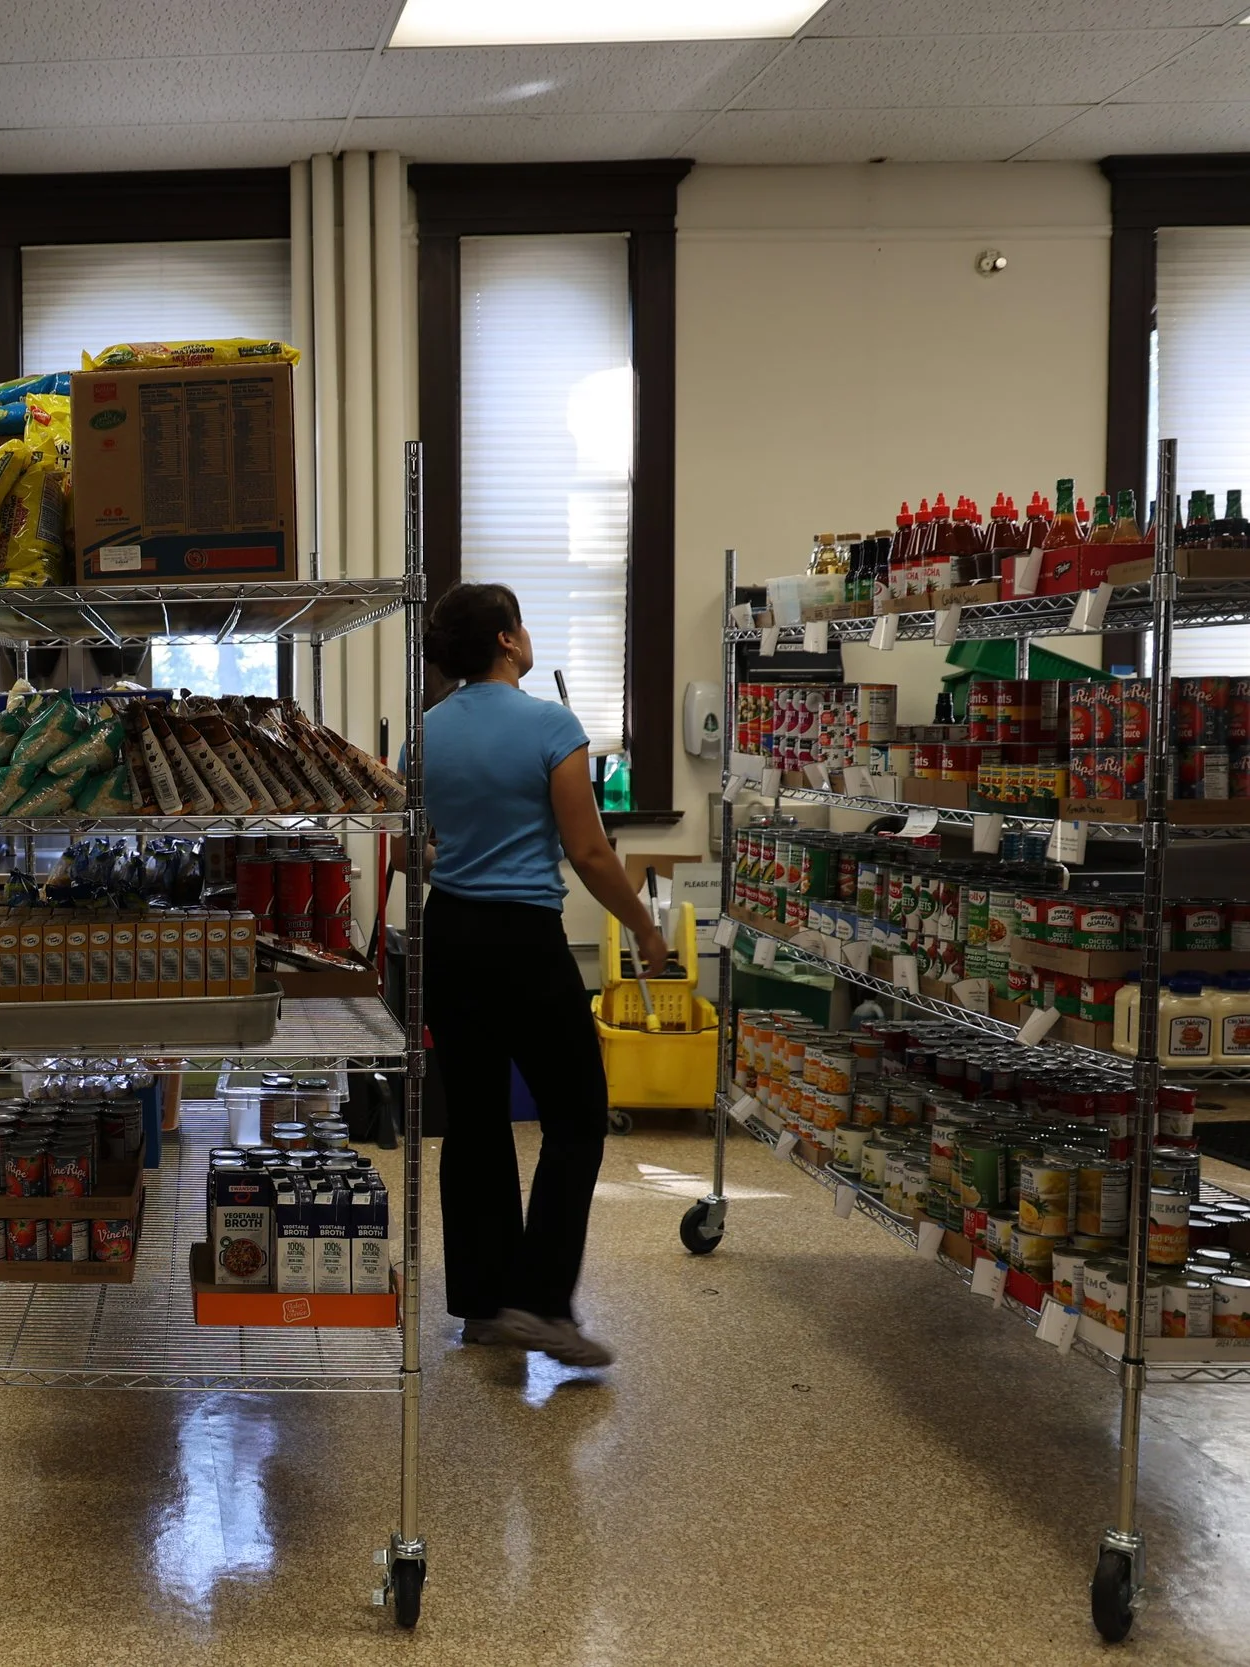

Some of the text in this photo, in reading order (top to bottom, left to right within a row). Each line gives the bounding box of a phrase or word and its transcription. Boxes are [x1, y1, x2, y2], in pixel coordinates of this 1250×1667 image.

[225, 1219, 262, 1228] BROTH
[288, 1242, 305, 1250] 100%
[324, 1242, 342, 1250] 100%
[362, 1242, 380, 1250] 100%
